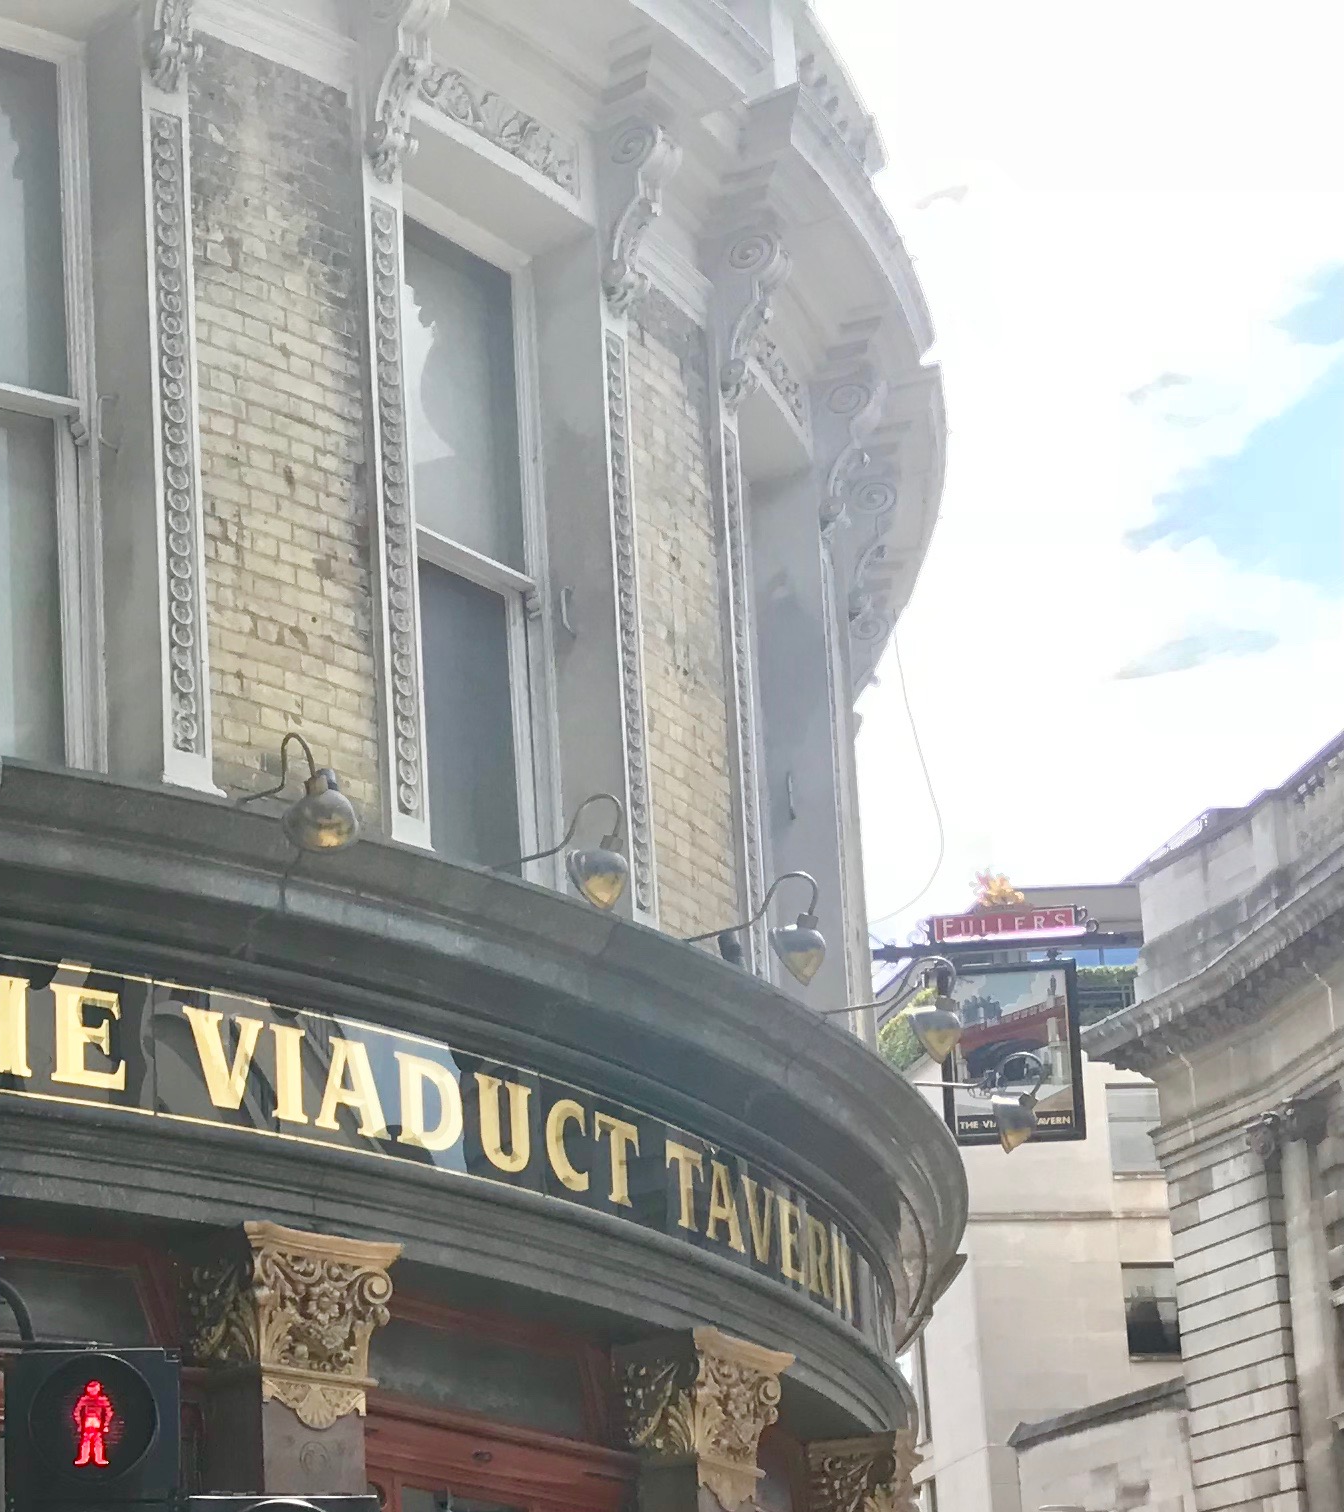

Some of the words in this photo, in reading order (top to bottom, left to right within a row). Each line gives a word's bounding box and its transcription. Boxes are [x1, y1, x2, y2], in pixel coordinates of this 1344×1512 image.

[182, 1004, 641, 1208] VIADUCT
[665, 1139, 853, 1324] TAVERN
[959, 1121, 979, 1130] THE
[1036, 1115, 1072, 1126] AVERN
